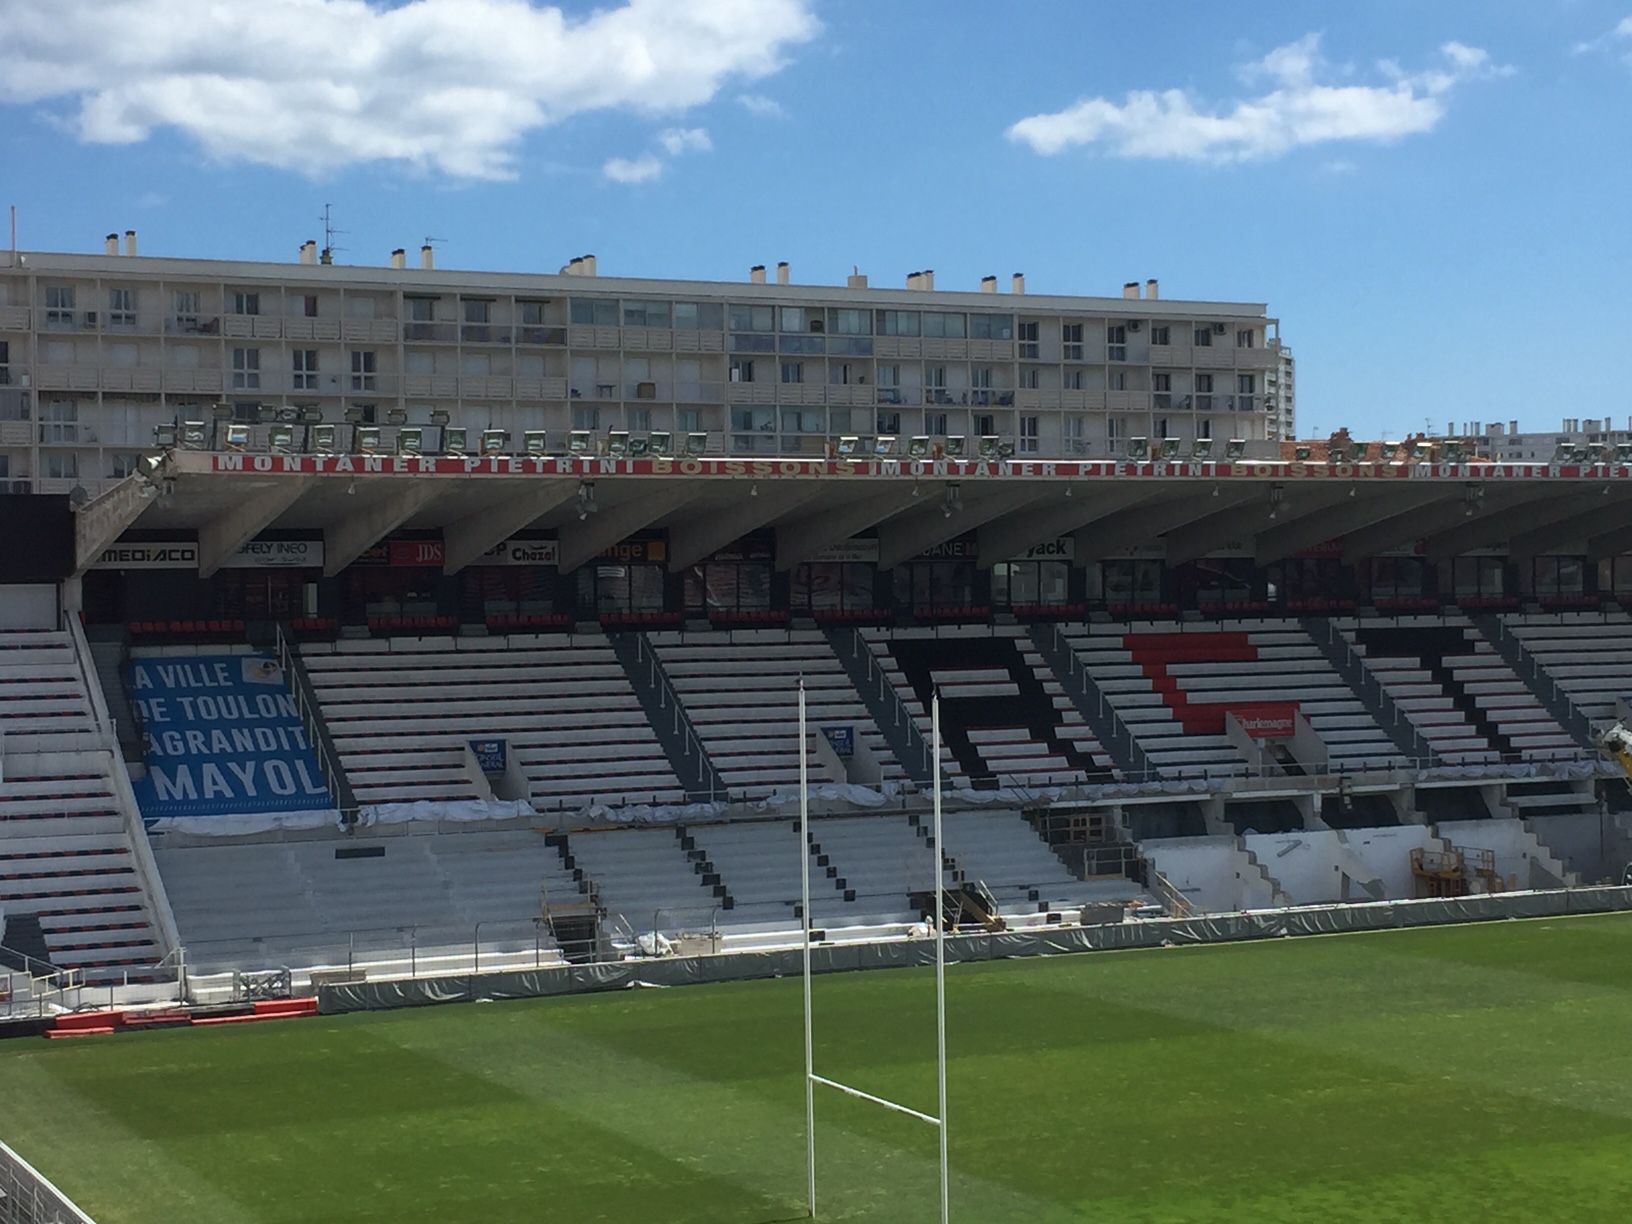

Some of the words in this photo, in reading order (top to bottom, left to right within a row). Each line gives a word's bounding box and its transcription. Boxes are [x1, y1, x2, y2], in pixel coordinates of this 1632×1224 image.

[217, 455, 436, 472] MONTANER
[464, 458, 634, 473] PIETRINI
[651, 459, 856, 475] BOISSONS
[881, 461, 1057, 476] MONTANER
[1078, 462, 1217, 477] PIETRINI
[1230, 462, 1398, 478] BOISSONS
[1414, 464, 1561, 478] MONTANER
[416, 544, 443, 562] JDS
[156, 663, 234, 688] VILLE
[176, 693, 299, 721] TOULON
[150, 759, 329, 801] MAYOL
